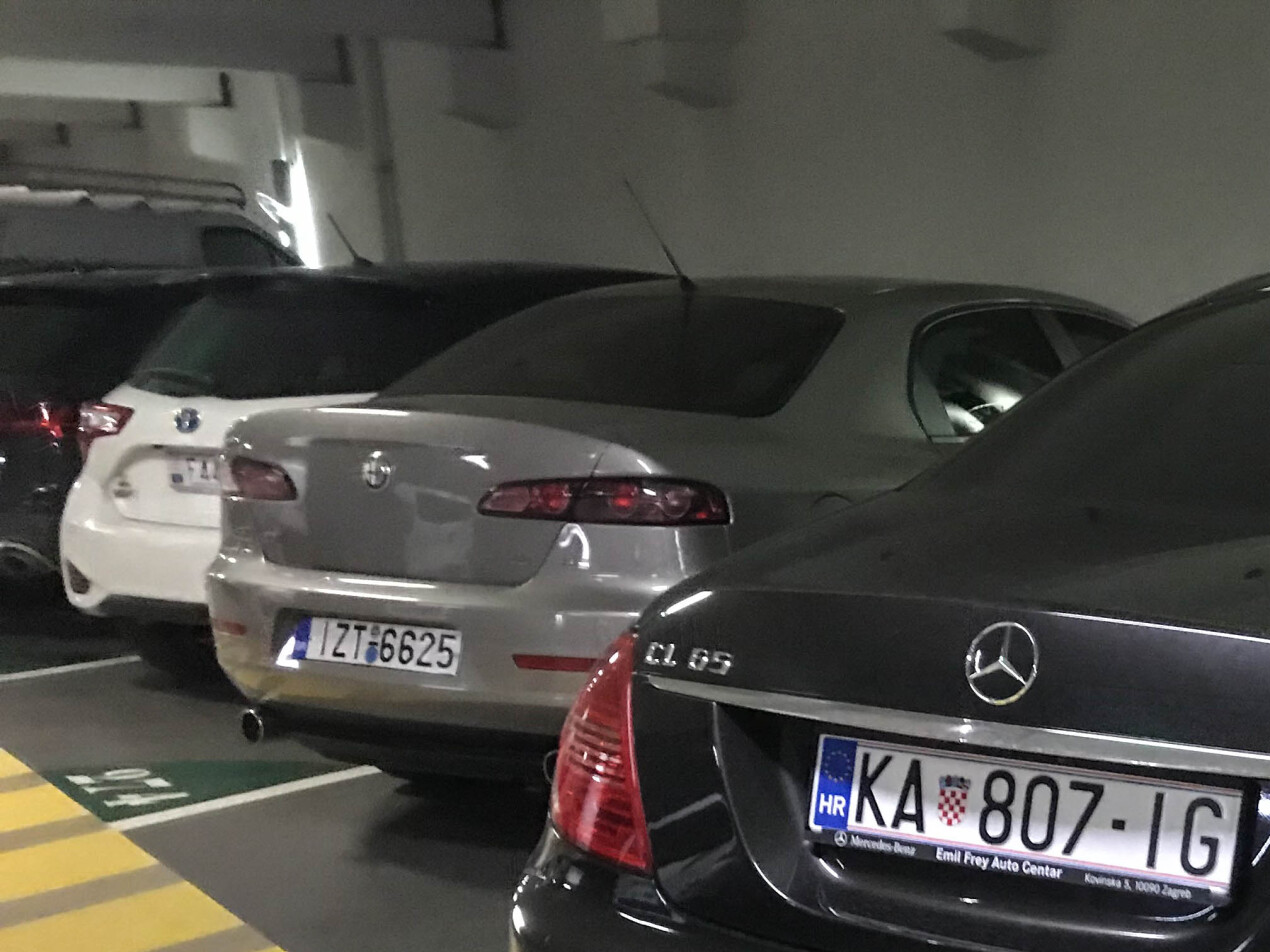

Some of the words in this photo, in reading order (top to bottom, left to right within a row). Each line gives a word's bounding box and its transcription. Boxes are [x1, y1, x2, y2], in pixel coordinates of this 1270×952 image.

[645, 641, 677, 667] CL
[688, 648, 734, 675] 65
[818, 793, 847, 818] HR
[855, 752, 925, 833] KA
[851, 834, 917, 857] Mercedes-Benz
[936, 847, 961, 864] Emil
[963, 851, 990, 870] Frey
[991, 856, 1020, 872] Auto
[1022, 860, 1063, 879] Centar
[1161, 884, 1192, 900] Zagreb
